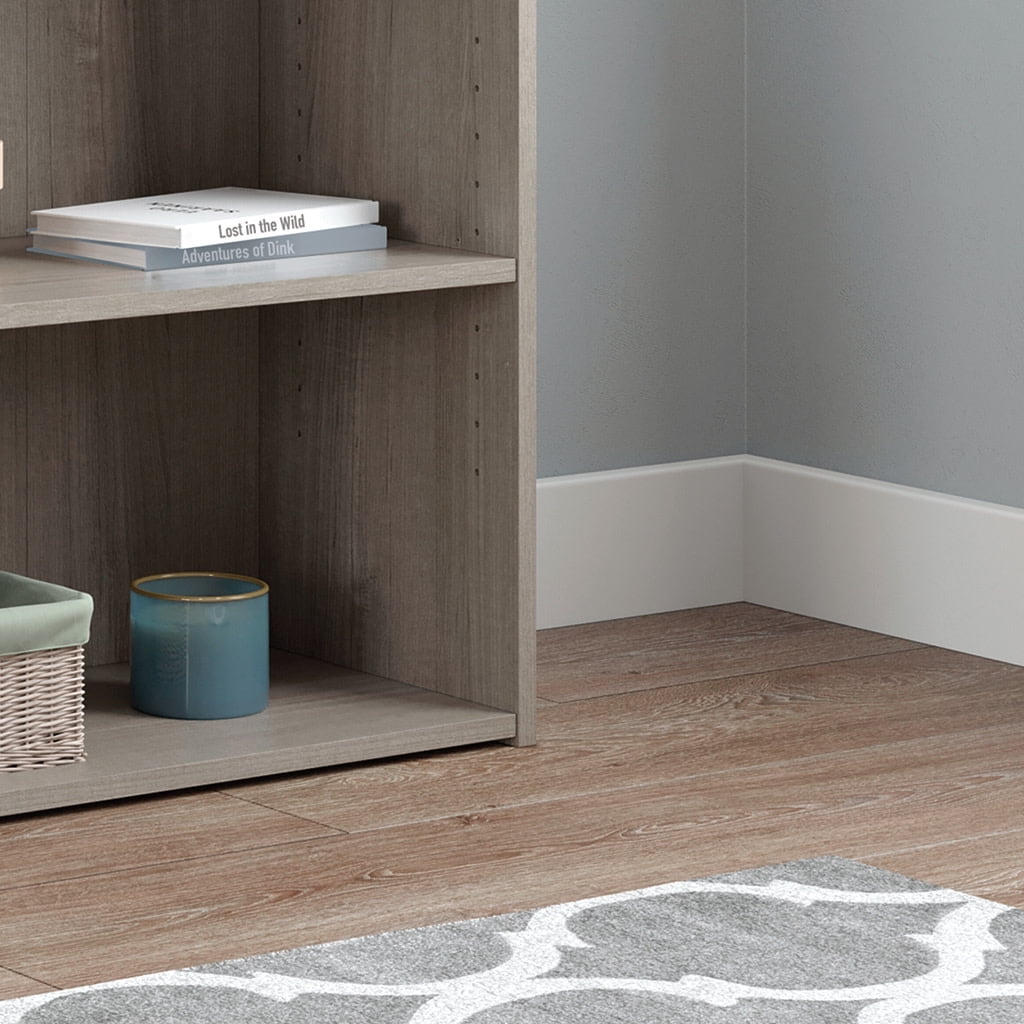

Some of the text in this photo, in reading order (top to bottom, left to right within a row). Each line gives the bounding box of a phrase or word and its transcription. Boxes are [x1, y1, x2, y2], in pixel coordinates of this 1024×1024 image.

[218, 214, 305, 239] Lost in the Wild
[182, 240, 295, 265] Adventures of Dink
